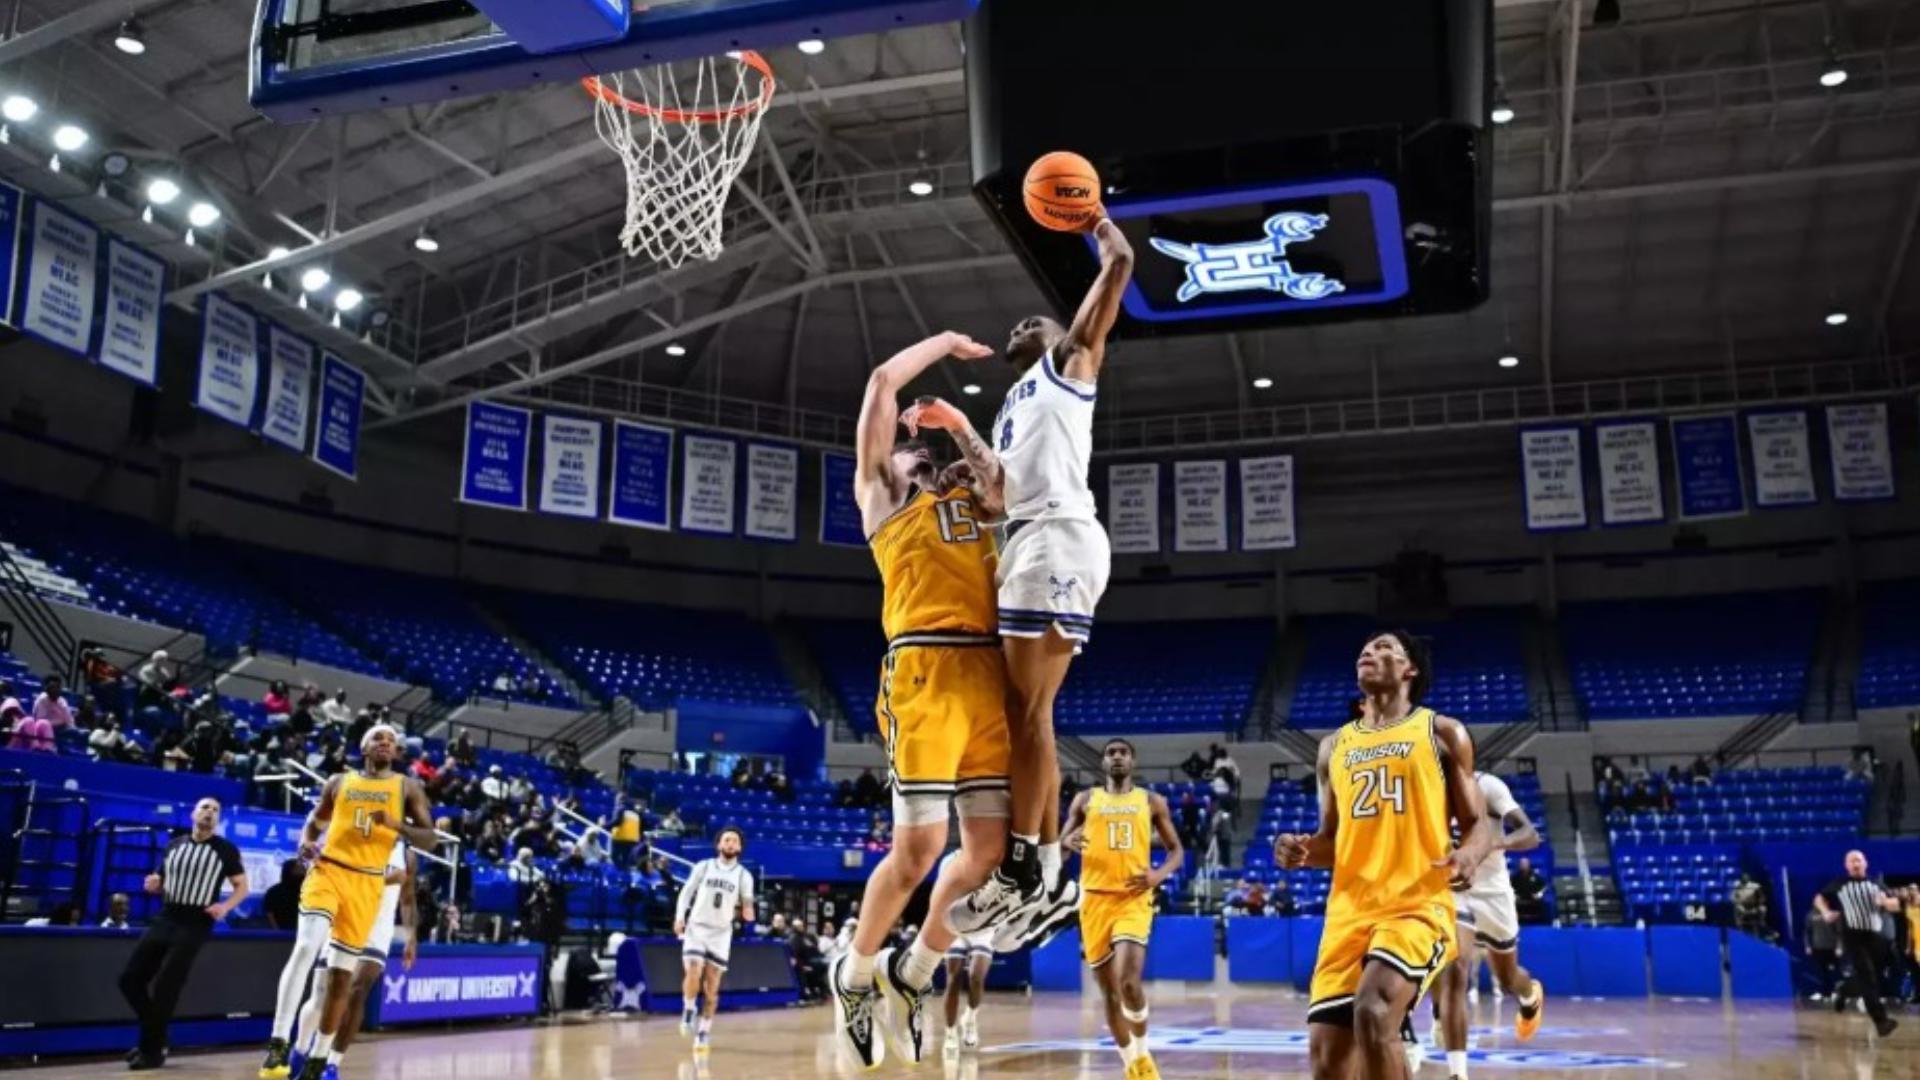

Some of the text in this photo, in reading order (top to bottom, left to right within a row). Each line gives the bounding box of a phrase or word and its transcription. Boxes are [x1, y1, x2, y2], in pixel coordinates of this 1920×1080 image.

[935, 500, 980, 542] 15
[1344, 742, 1415, 769] TOWSON
[1351, 764, 1406, 819] 24
[353, 806, 374, 840] 4
[1107, 821, 1133, 851] 13
[408, 975, 517, 1003] HAMPTON UNIVERSITY
